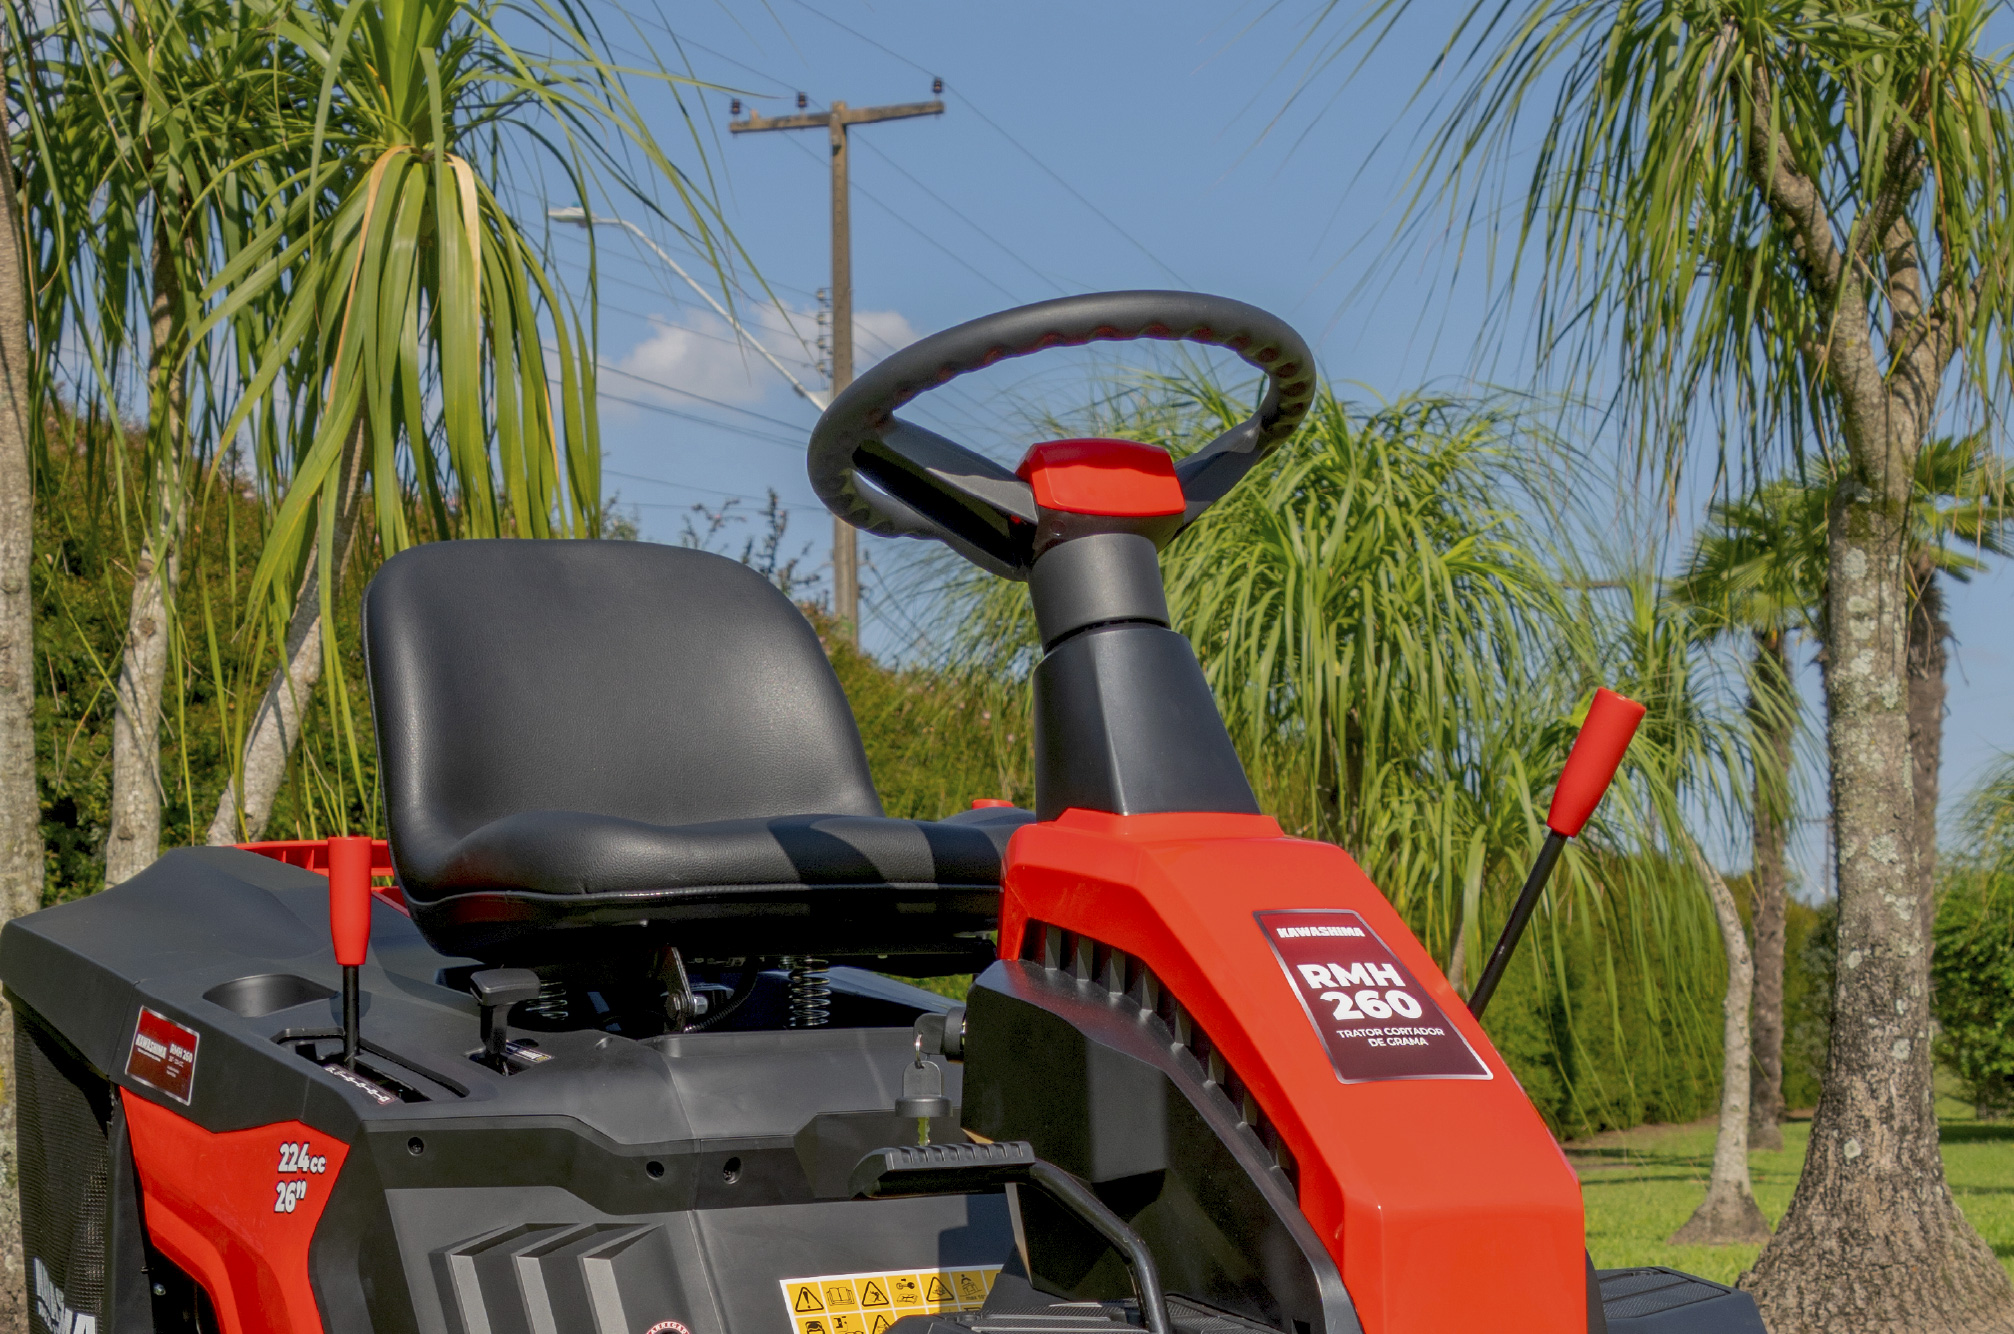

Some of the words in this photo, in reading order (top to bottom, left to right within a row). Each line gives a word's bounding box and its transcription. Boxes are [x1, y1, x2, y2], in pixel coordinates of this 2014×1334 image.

[1276, 926, 1366, 938] KAWASHIMA
[1296, 963, 1406, 989] RMH
[1320, 990, 1422, 1021] 260
[1336, 1028, 1383, 1039] TRATOR
[1384, 1027, 1445, 1036] CORTADOR
[1367, 1038, 1386, 1047] DE
[1386, 1037, 1429, 1046] GRAMA
[278, 1142, 326, 1173] 224cc
